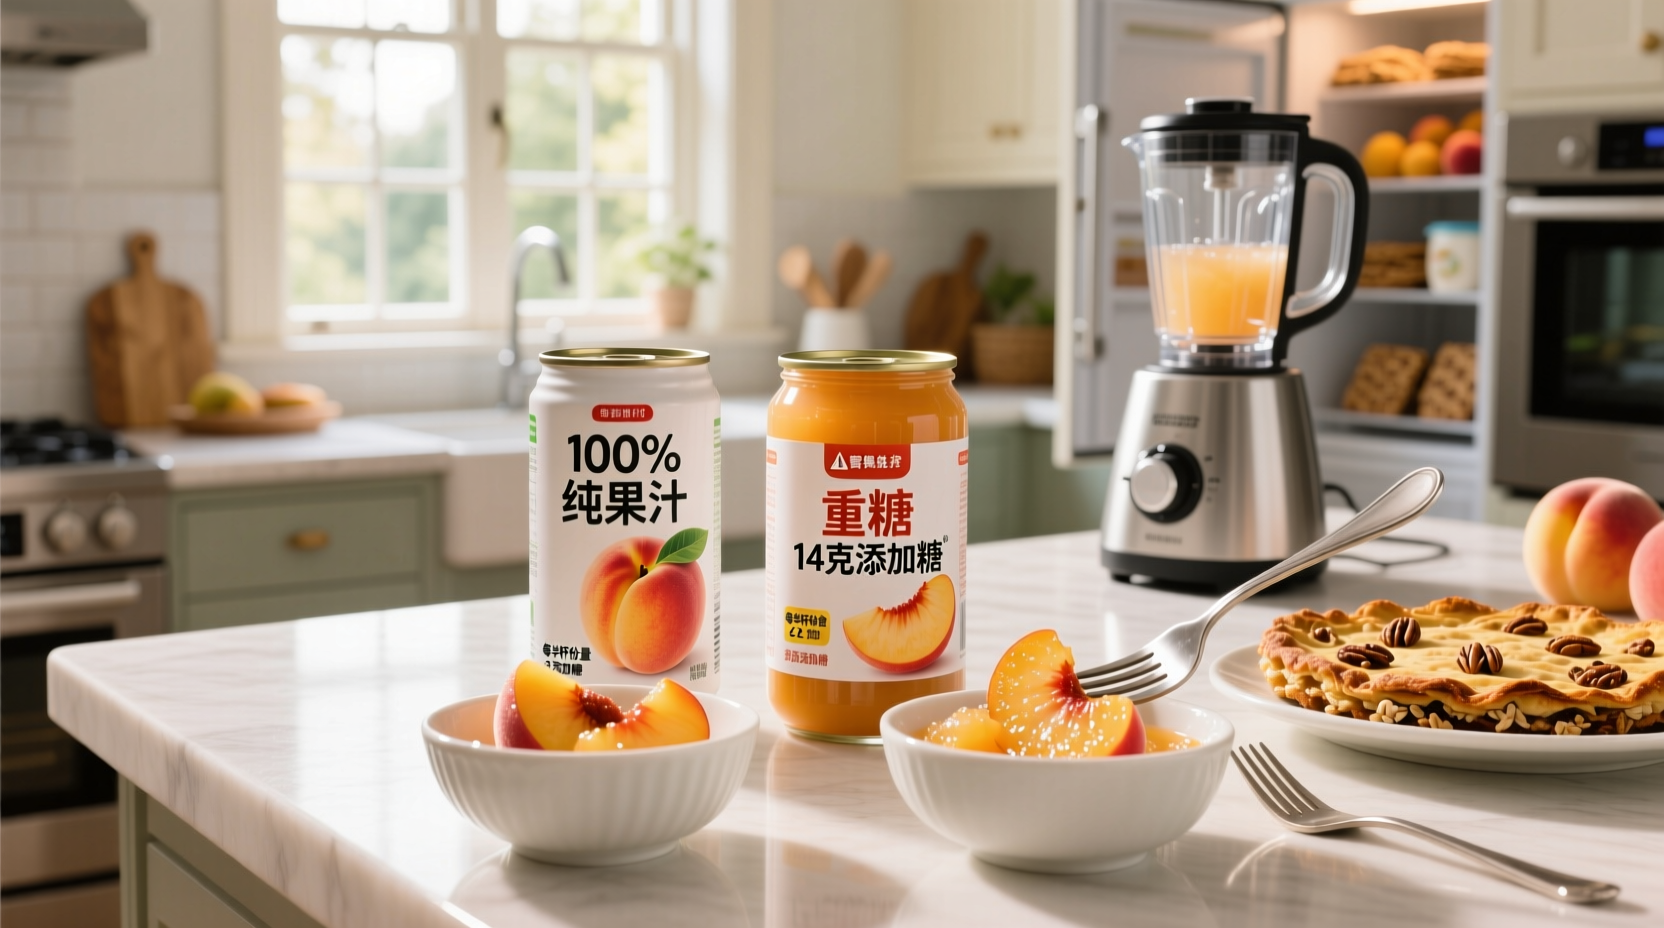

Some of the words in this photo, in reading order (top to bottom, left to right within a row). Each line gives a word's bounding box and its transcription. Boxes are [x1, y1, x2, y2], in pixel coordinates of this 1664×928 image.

[567, 433, 681, 474] 100%
[561, 478, 688, 526] 纯果汁
[822, 488, 914, 537] 重糖
[793, 539, 943, 576] 14克添加糖
